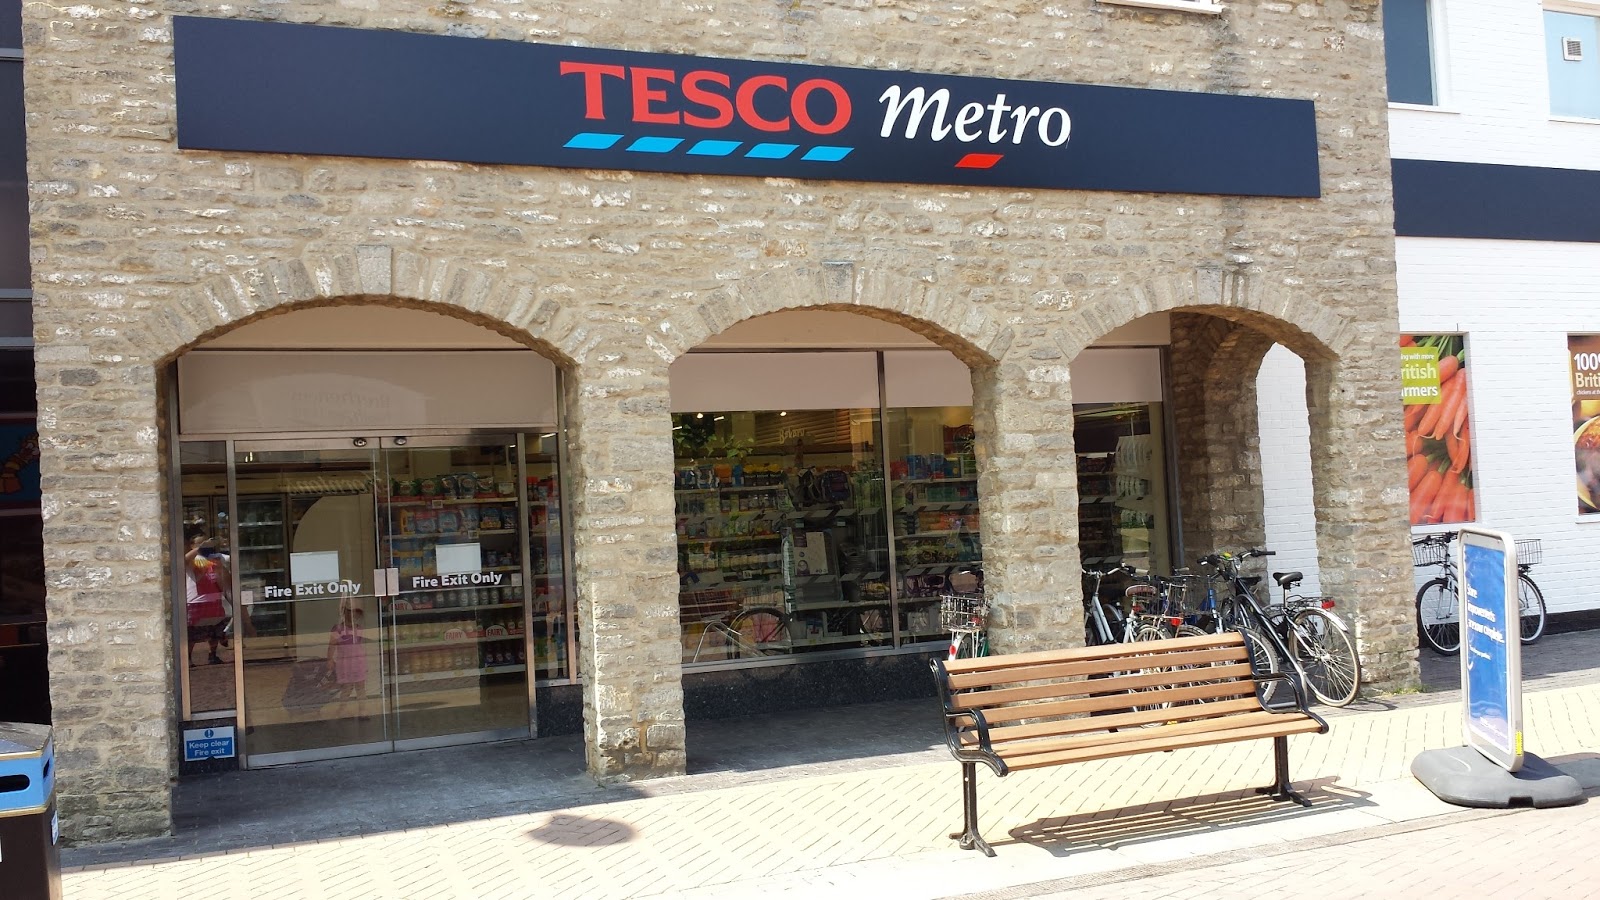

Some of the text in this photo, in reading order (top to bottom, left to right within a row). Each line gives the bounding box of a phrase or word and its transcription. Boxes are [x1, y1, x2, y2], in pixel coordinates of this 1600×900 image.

[560, 61, 1071, 147] TESCO Metro
[412, 571, 502, 588] Fire Exit Only
[264, 580, 361, 598] Fire Exit Only
